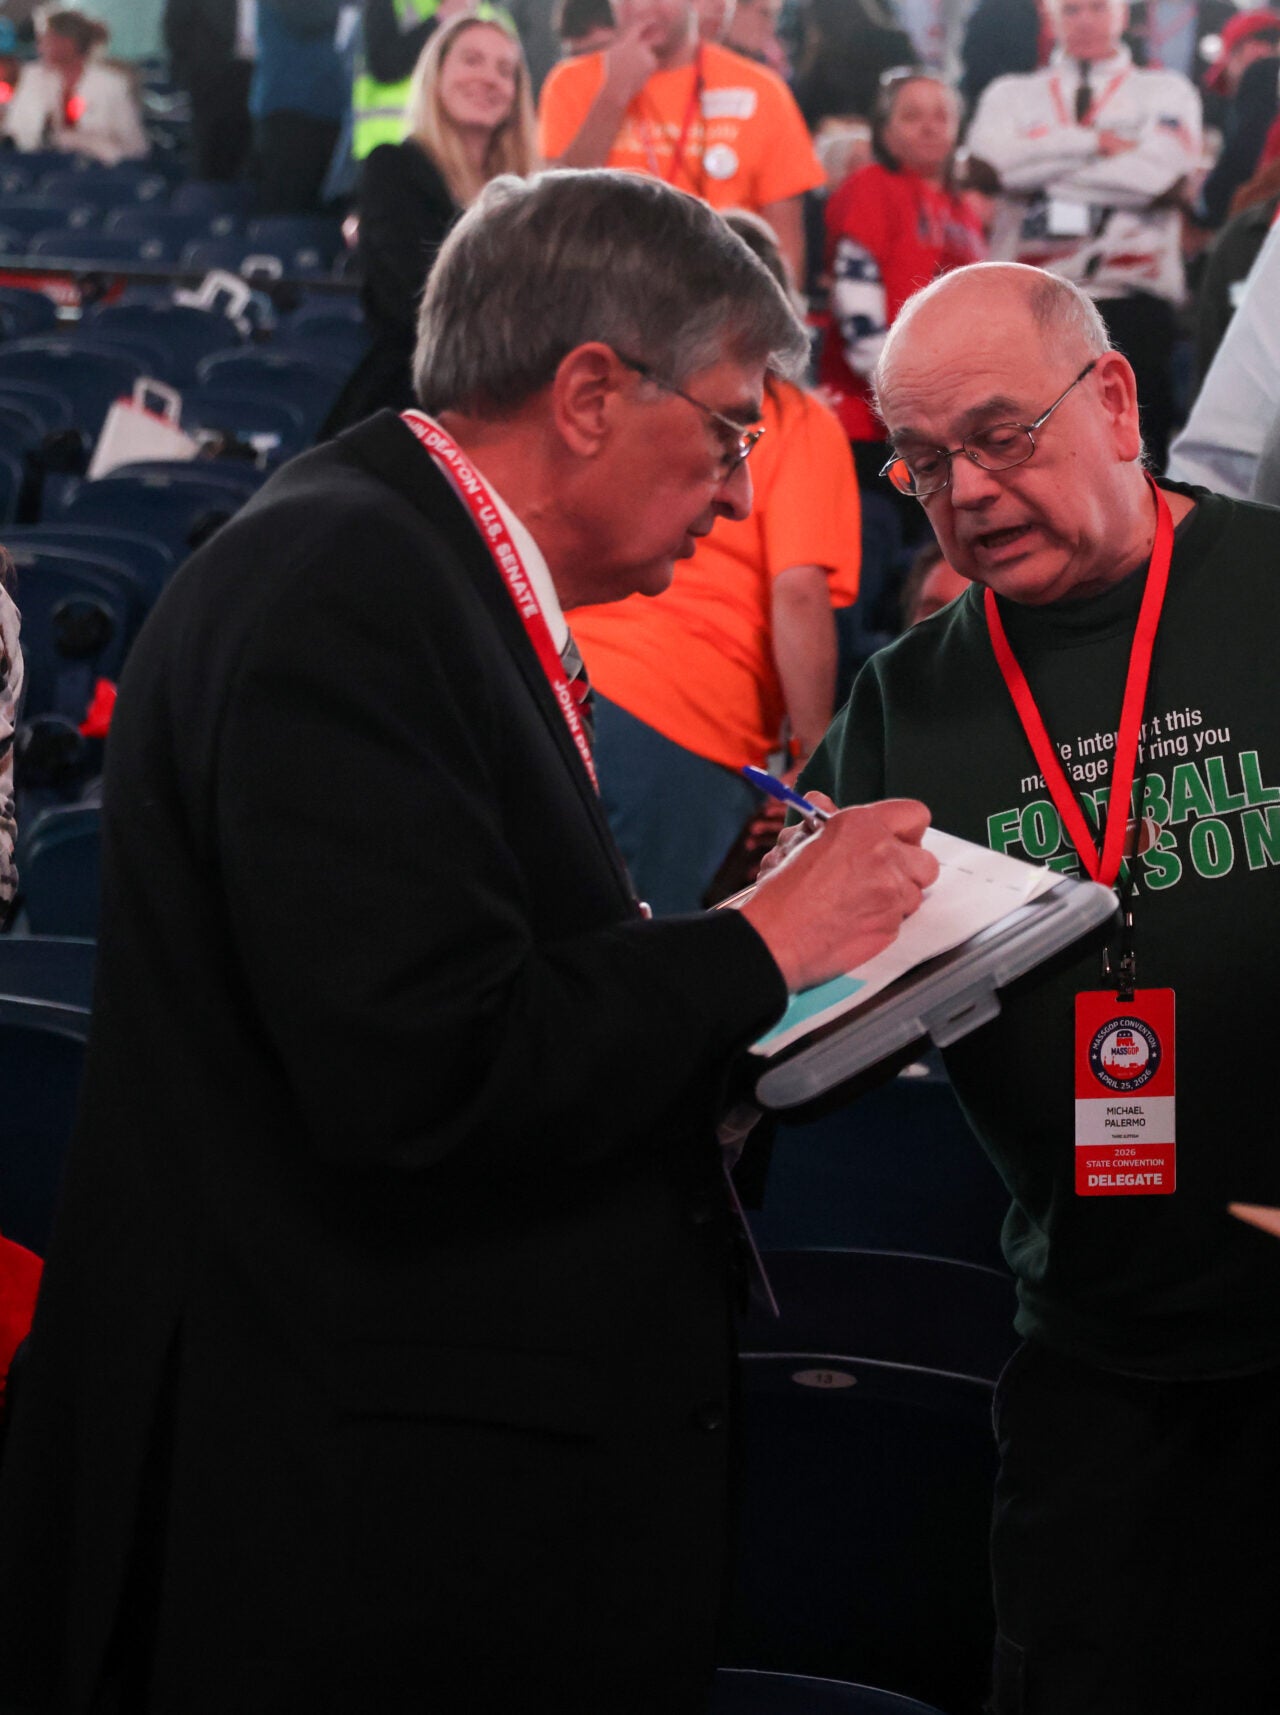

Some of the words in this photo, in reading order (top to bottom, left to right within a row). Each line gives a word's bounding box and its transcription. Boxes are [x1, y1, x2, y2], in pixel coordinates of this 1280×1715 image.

[423, 431, 481, 494] DEATON
[495, 543, 539, 619] SENATE
[554, 680, 580, 733] JOHN
[1165, 708, 1202, 731] this
[1194, 726, 1230, 754] you
[1093, 1021, 1119, 1050] MASSGOP
[1120, 1019, 1157, 1049] CONVENTION
[1111, 1047, 1139, 1056] MASSGOP
[1097, 1072, 1119, 1089] APRIL
[1121, 1082, 1134, 1090] 25,
[1134, 1069, 1152, 1086] 2026
[1106, 1106, 1144, 1115] MICHAEL
[1104, 1118, 1146, 1127] PALERMO
[1114, 1148, 1136, 1157] 2026
[1086, 1160, 1111, 1168] STATE
[1112, 1159, 1164, 1168] CONVENTION
[1088, 1173, 1163, 1187] DELEGATE
